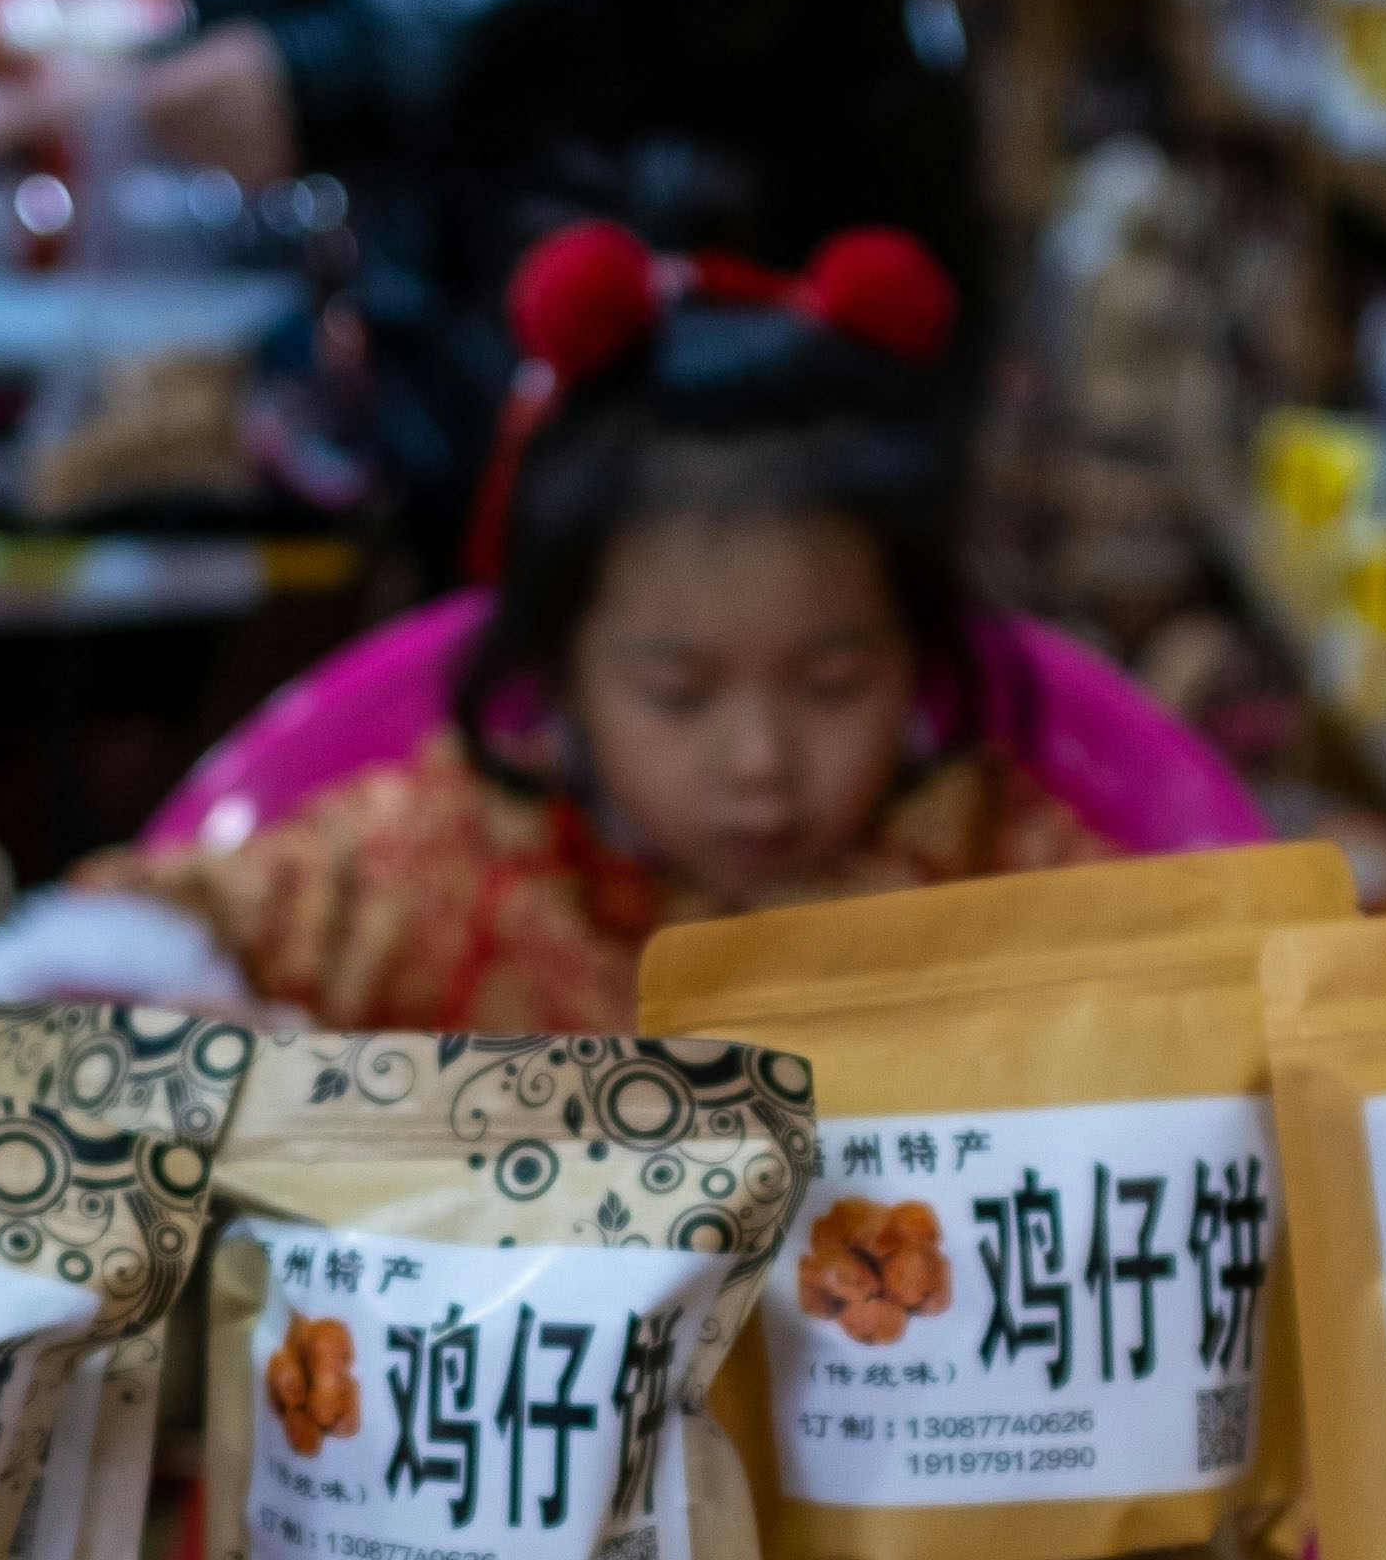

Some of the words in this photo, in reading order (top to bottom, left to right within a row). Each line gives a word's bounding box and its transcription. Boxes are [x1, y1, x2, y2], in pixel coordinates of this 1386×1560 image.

[260, 1241, 423, 1297] 州特产
[972, 1153, 1270, 1392] 鸡仔饼
[385, 1300, 683, 1532] 鸡仔饼
[907, 1446, 1097, 1478] 19197912990
